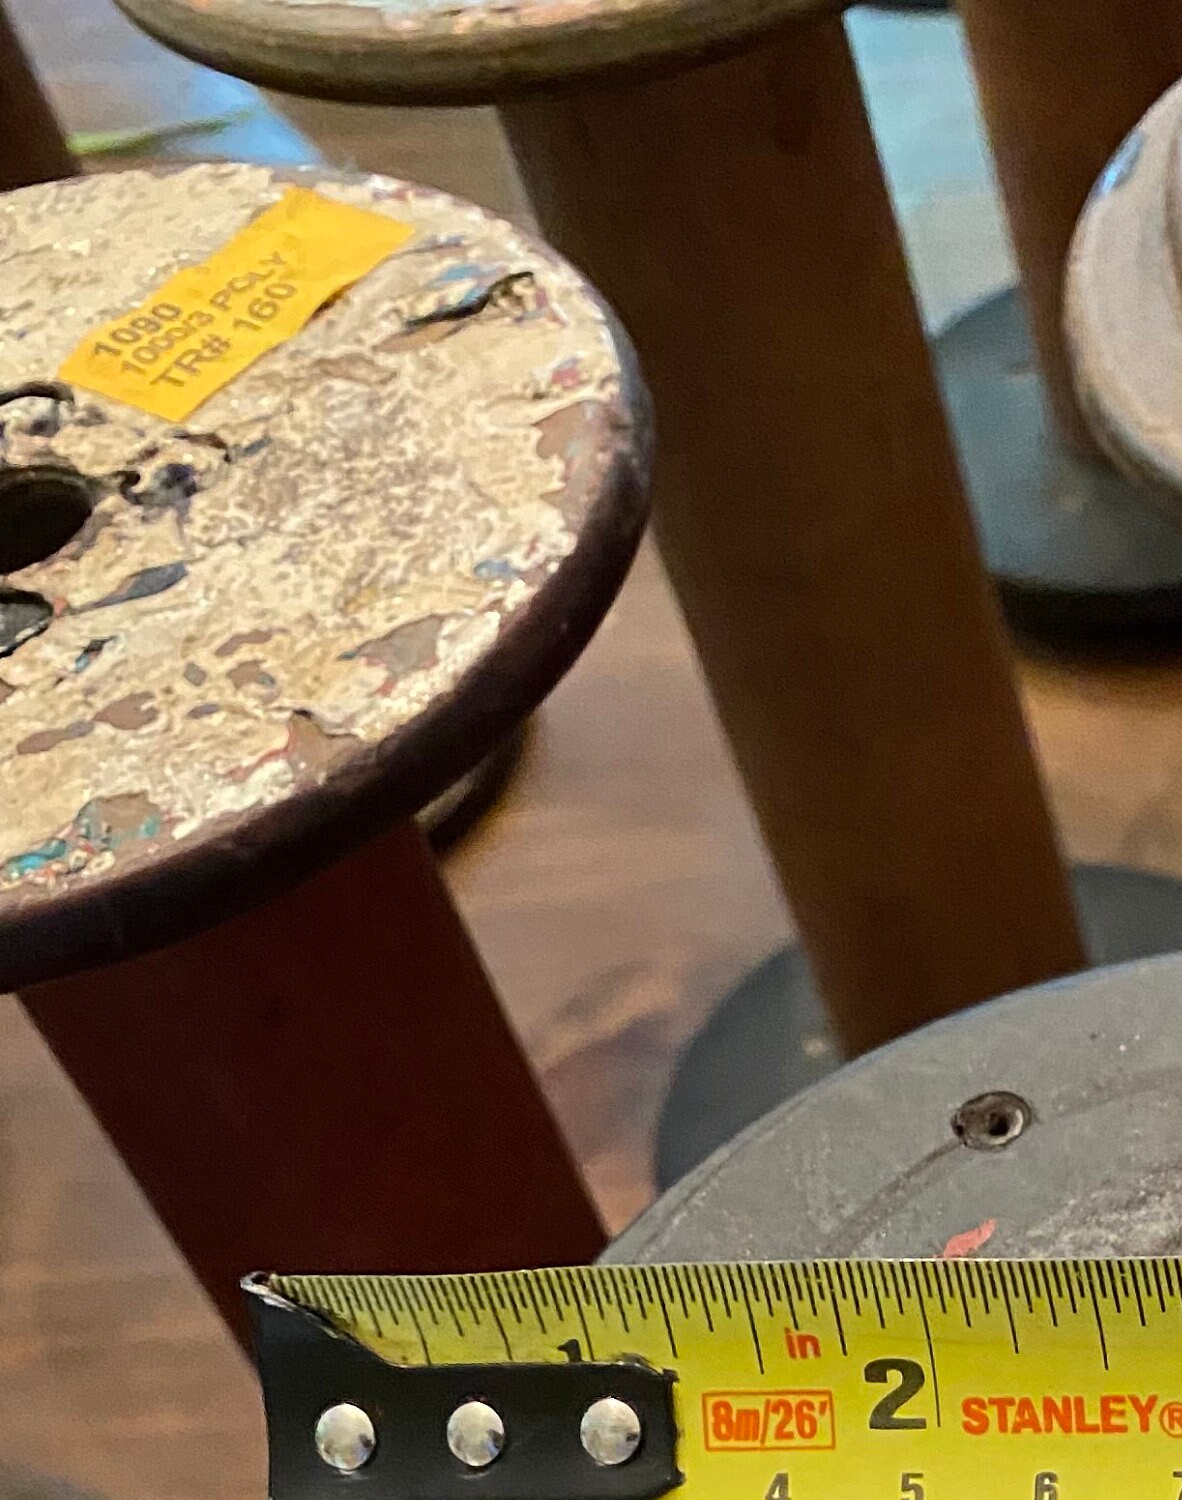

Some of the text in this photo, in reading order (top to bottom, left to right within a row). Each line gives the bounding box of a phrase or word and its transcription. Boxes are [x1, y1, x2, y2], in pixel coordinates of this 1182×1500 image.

[209, 251, 287, 312] POLY
[93, 302, 183, 357] 1090
[150, 282, 298, 388] TR# 160
[784, 1326, 821, 1360] in
[711, 1398, 829, 1446] 8m/26'
[864, 1358, 927, 1430] 2
